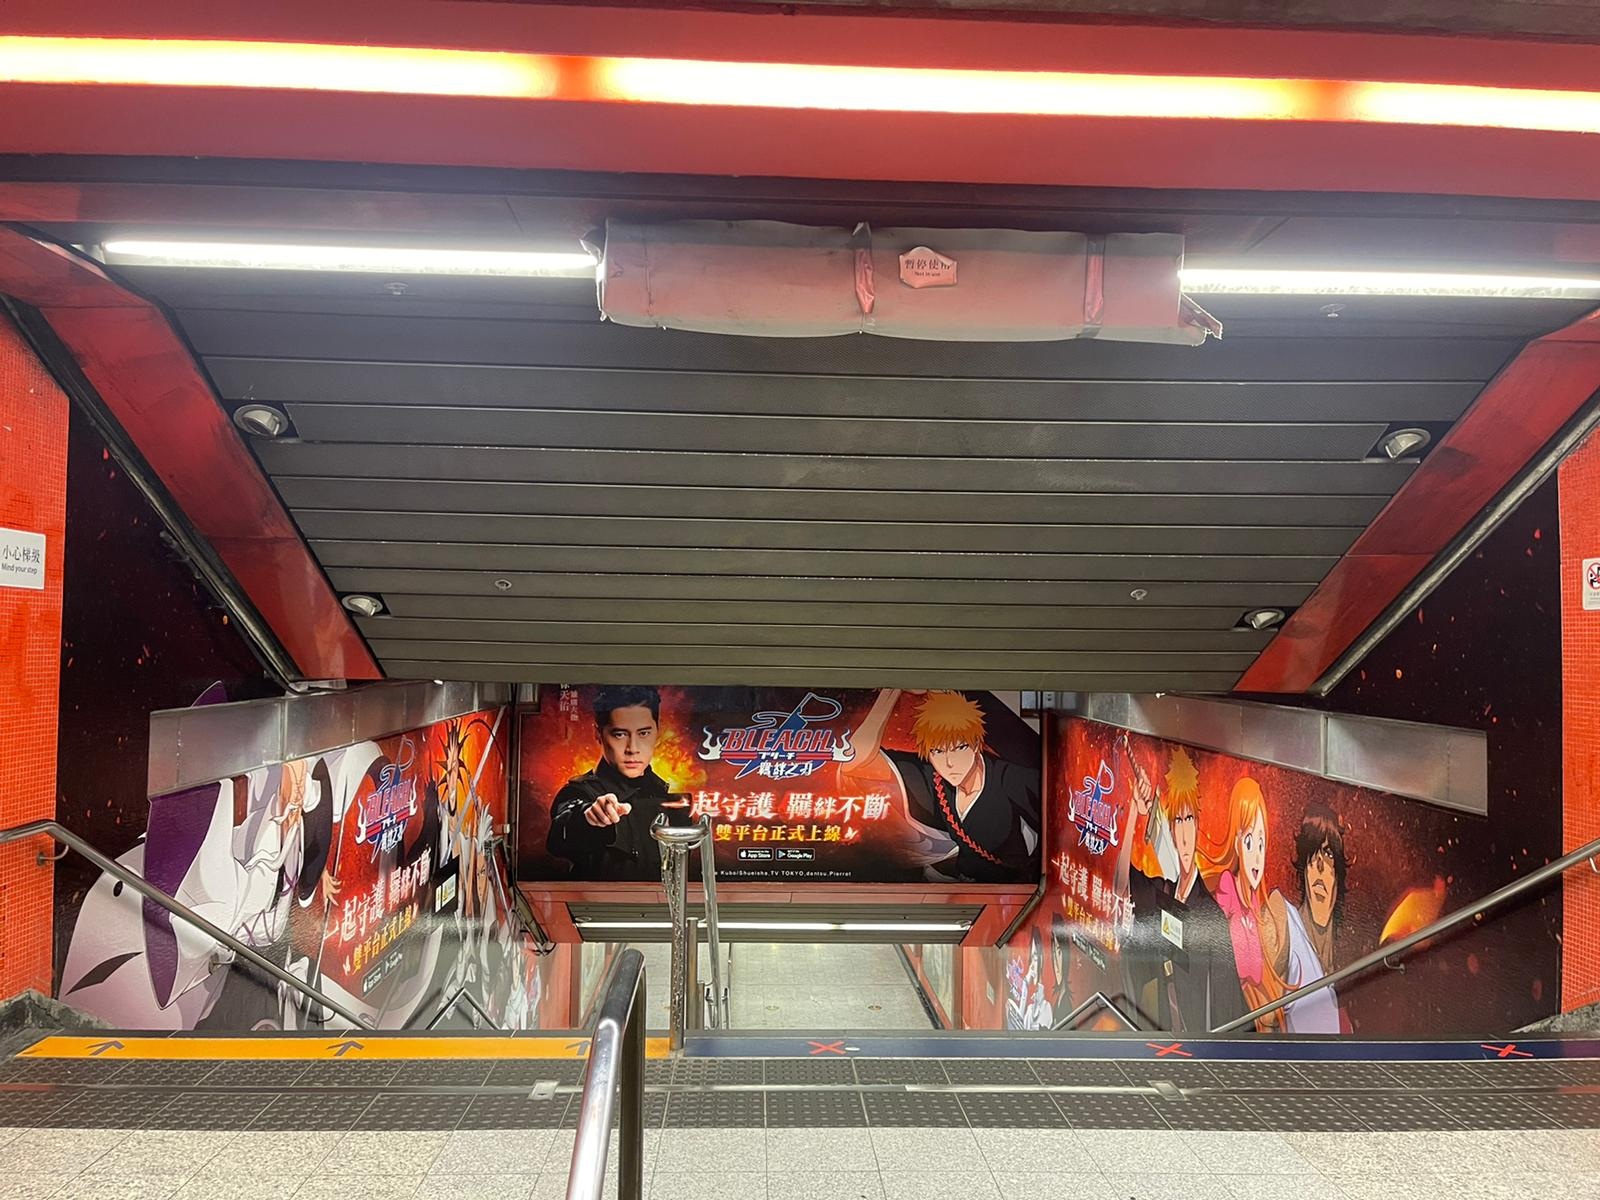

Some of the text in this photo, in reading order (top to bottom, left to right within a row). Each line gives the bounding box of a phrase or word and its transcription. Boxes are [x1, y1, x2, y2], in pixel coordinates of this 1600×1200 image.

[2, 562, 38, 575] Mind your step
[721, 729, 833, 751] BLEACH
[660, 791, 892, 822] 一起守護 羈絆不斷
[714, 824, 842, 842] 雙平台正式上線
